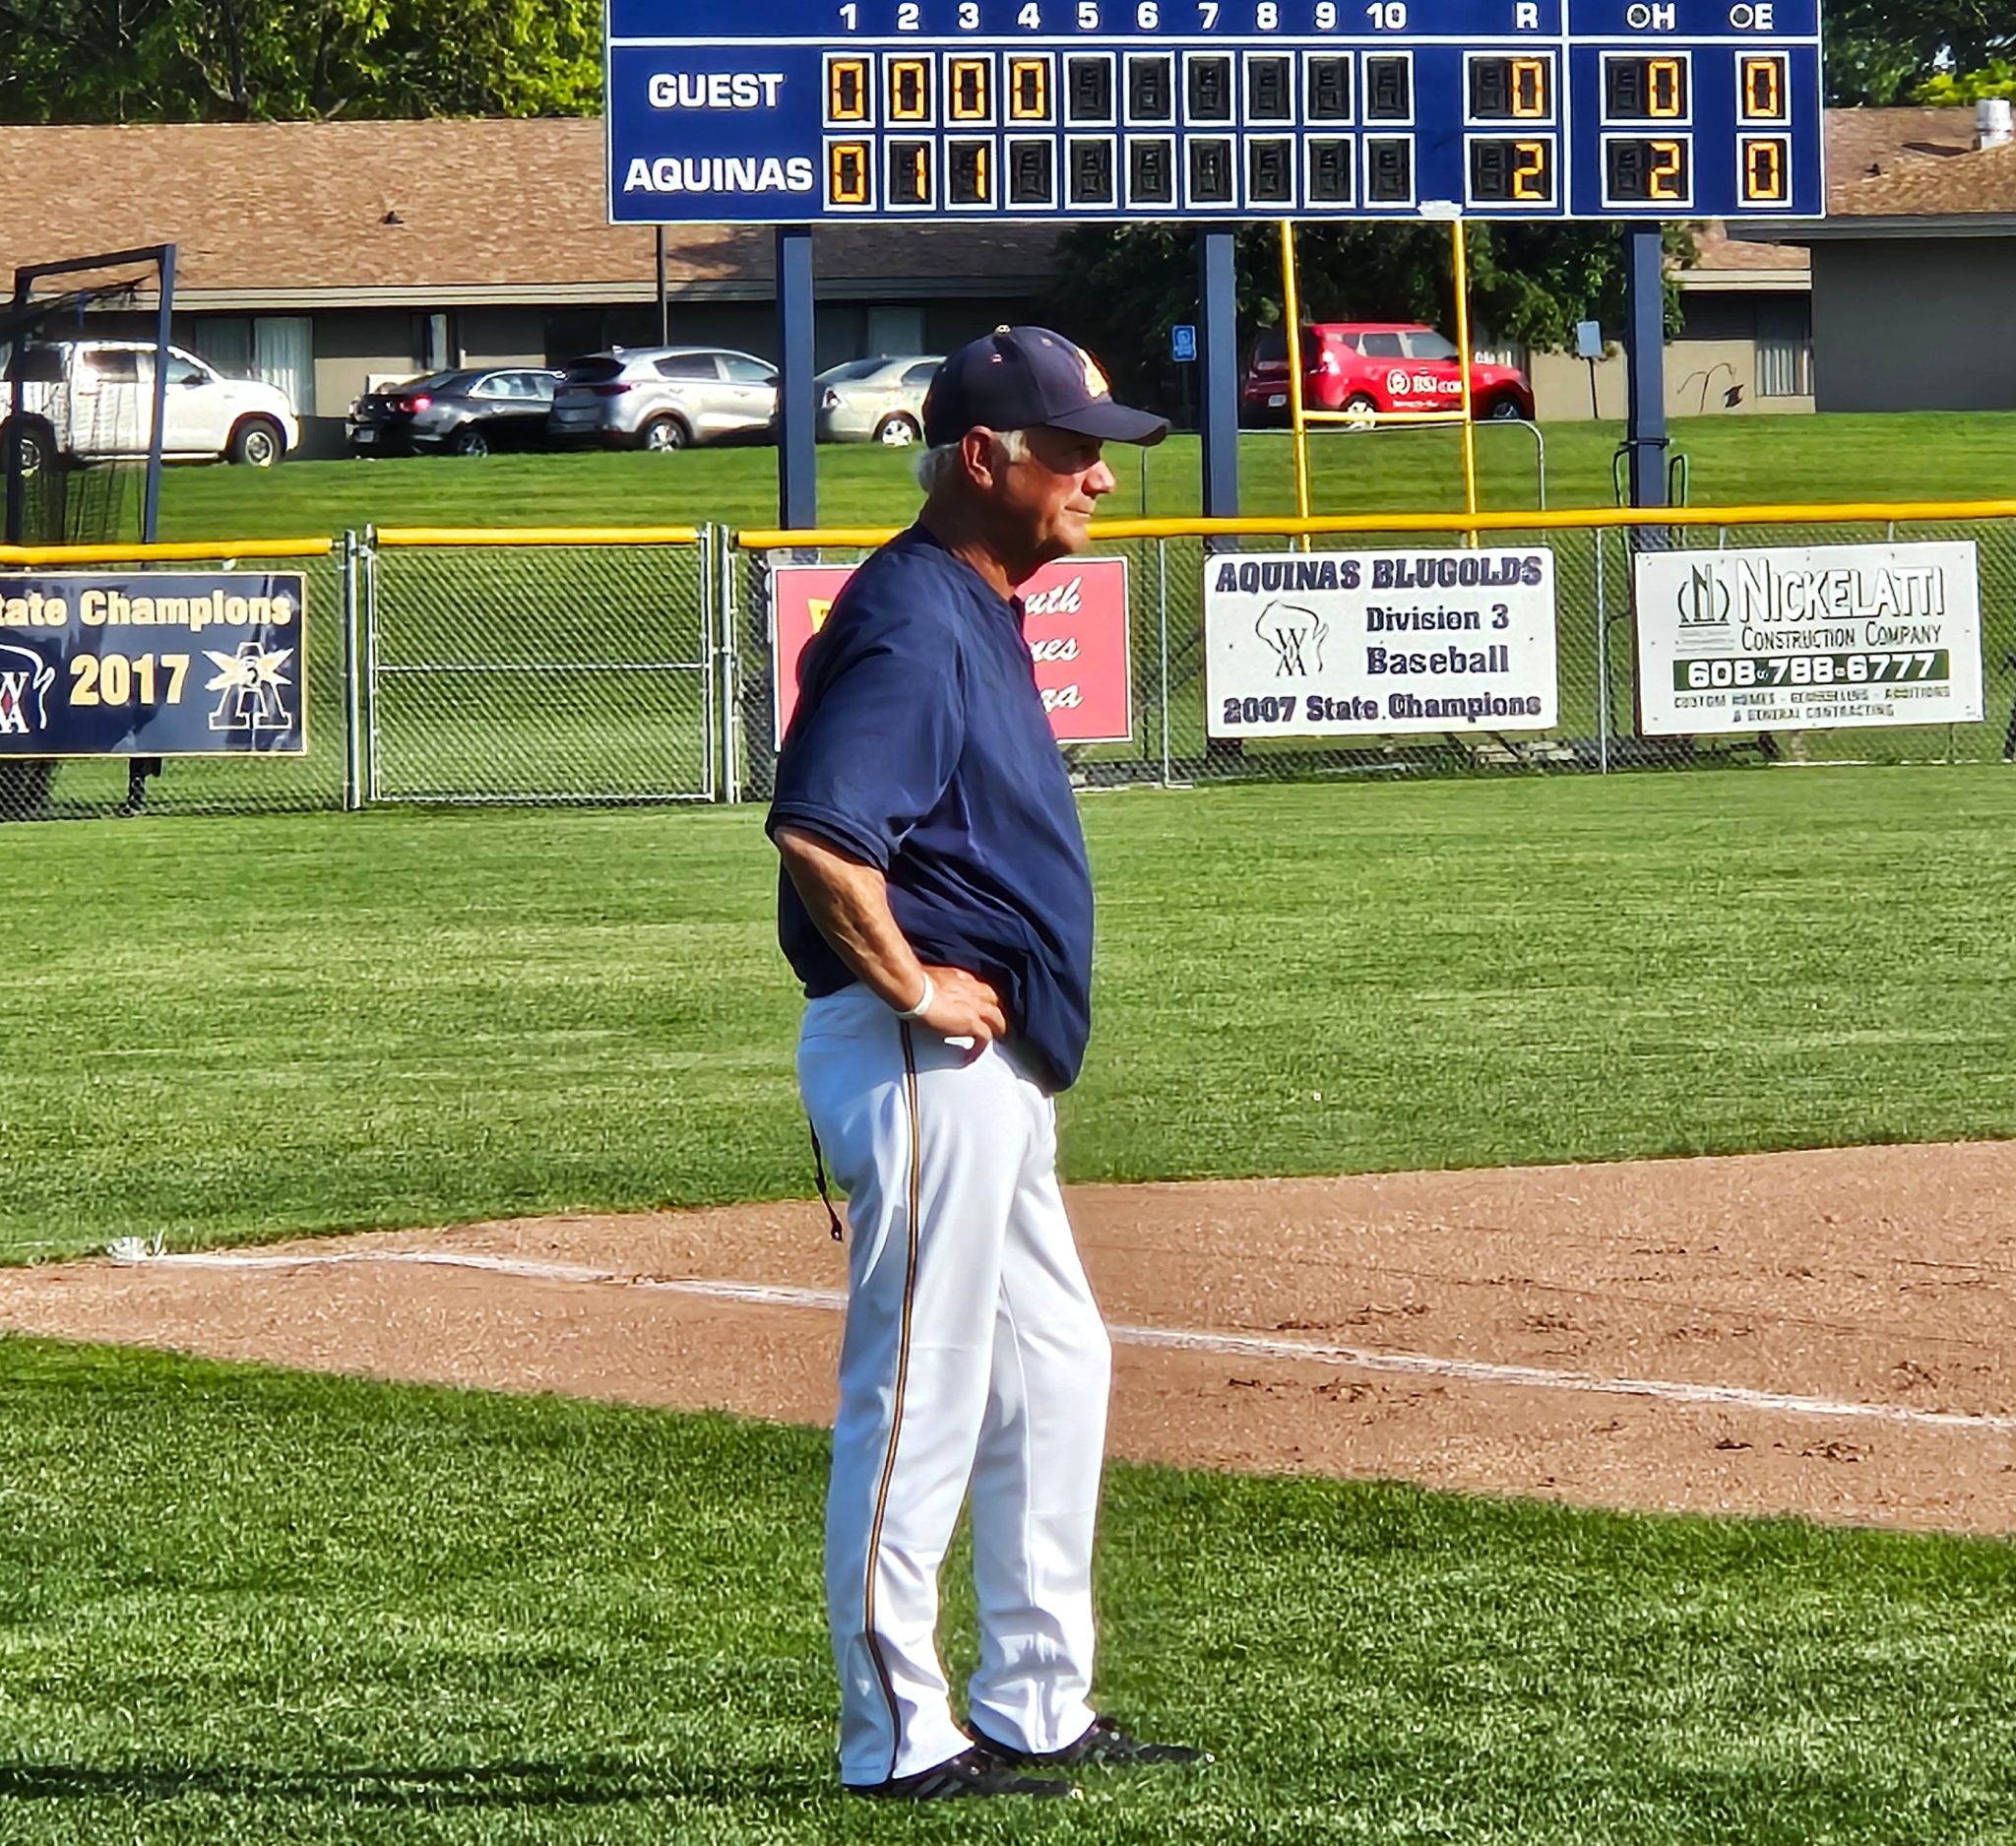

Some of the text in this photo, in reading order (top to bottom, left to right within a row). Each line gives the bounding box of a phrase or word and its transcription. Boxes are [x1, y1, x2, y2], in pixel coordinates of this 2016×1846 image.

[840, 3, 856, 30] 1
[899, 3, 919, 30] 2
[959, 3, 979, 29] 3
[1018, 3, 1040, 29] 4
[1079, 2, 1098, 29] 5
[1138, 2, 1159, 29] 6
[1199, 2, 1219, 29] 7
[1257, 2, 1278, 30] 8
[1316, 2, 1336, 29] 9
[1366, 2, 1407, 29] 10
[1517, 2, 1538, 29] R
[648, 73, 784, 108] GUEST
[623, 157, 813, 193] AQUINAS
[1514, 143, 1544, 199] 2
[1650, 142, 1680, 199] 2
[1216, 556, 1544, 595] AQUINAS BLUGOLDS
[79, 590, 292, 632] Champions
[1365, 604, 1509, 632] Division 3
[1366, 645, 1510, 675] Baseball
[69, 653, 190, 706] 2017
[1223, 691, 1542, 725] 2007 State Champions
